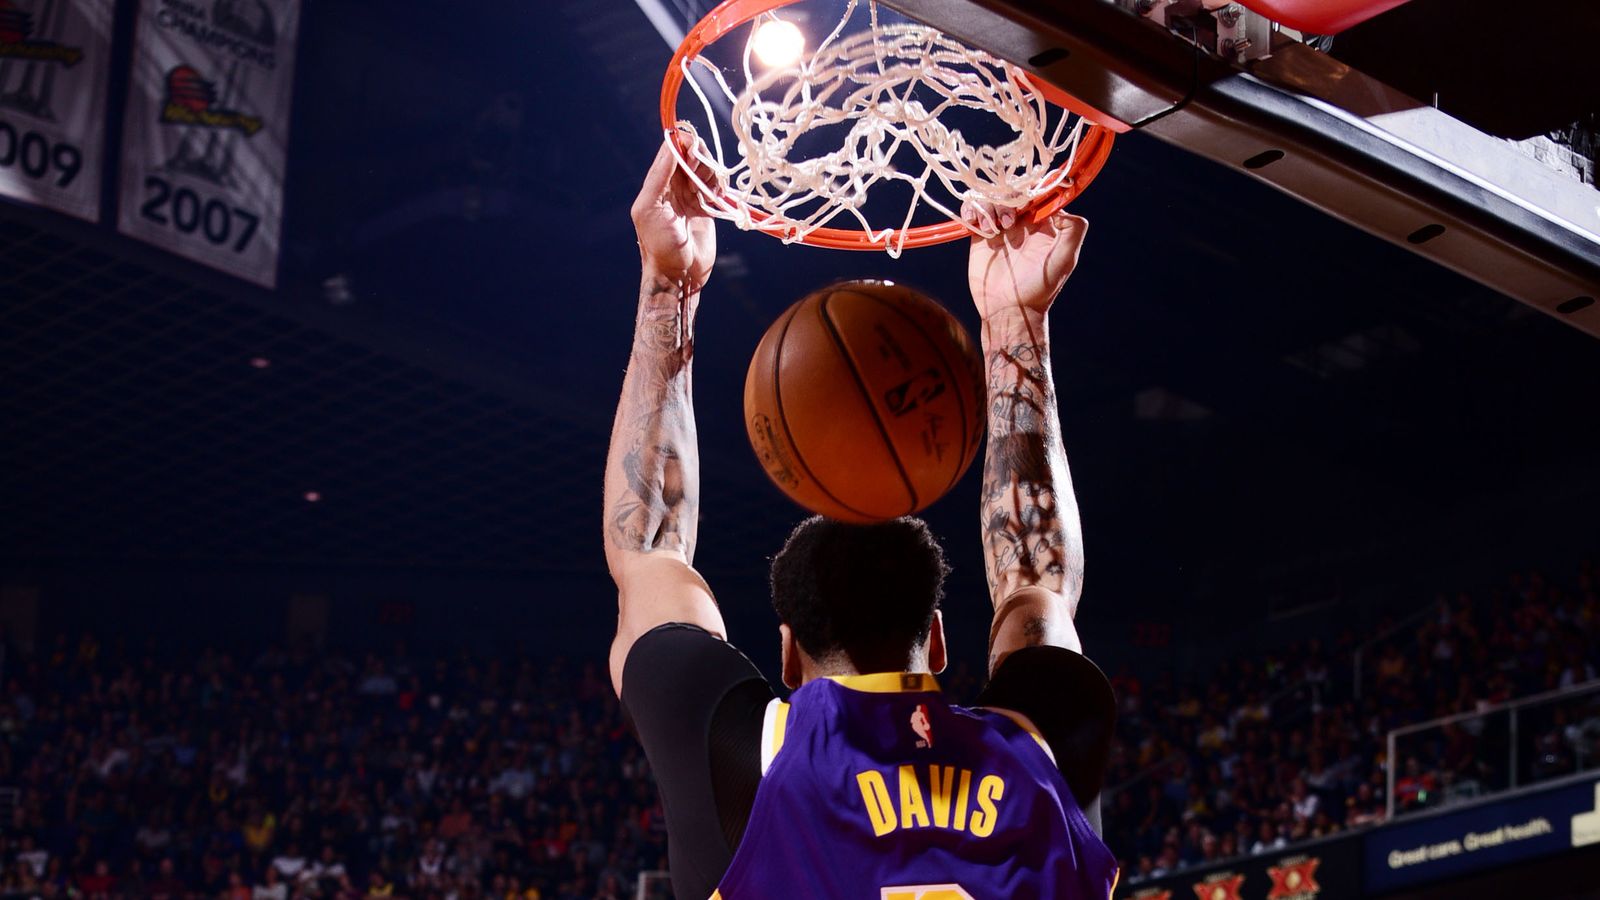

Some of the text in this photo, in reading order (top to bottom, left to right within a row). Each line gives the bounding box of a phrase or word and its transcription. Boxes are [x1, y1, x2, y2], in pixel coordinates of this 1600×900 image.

[158, 8, 276, 70] CHAMPIONS
[142, 175, 258, 252] 2007
[855, 763, 1005, 838] DAVIS
[1463, 829, 1504, 851] Great
